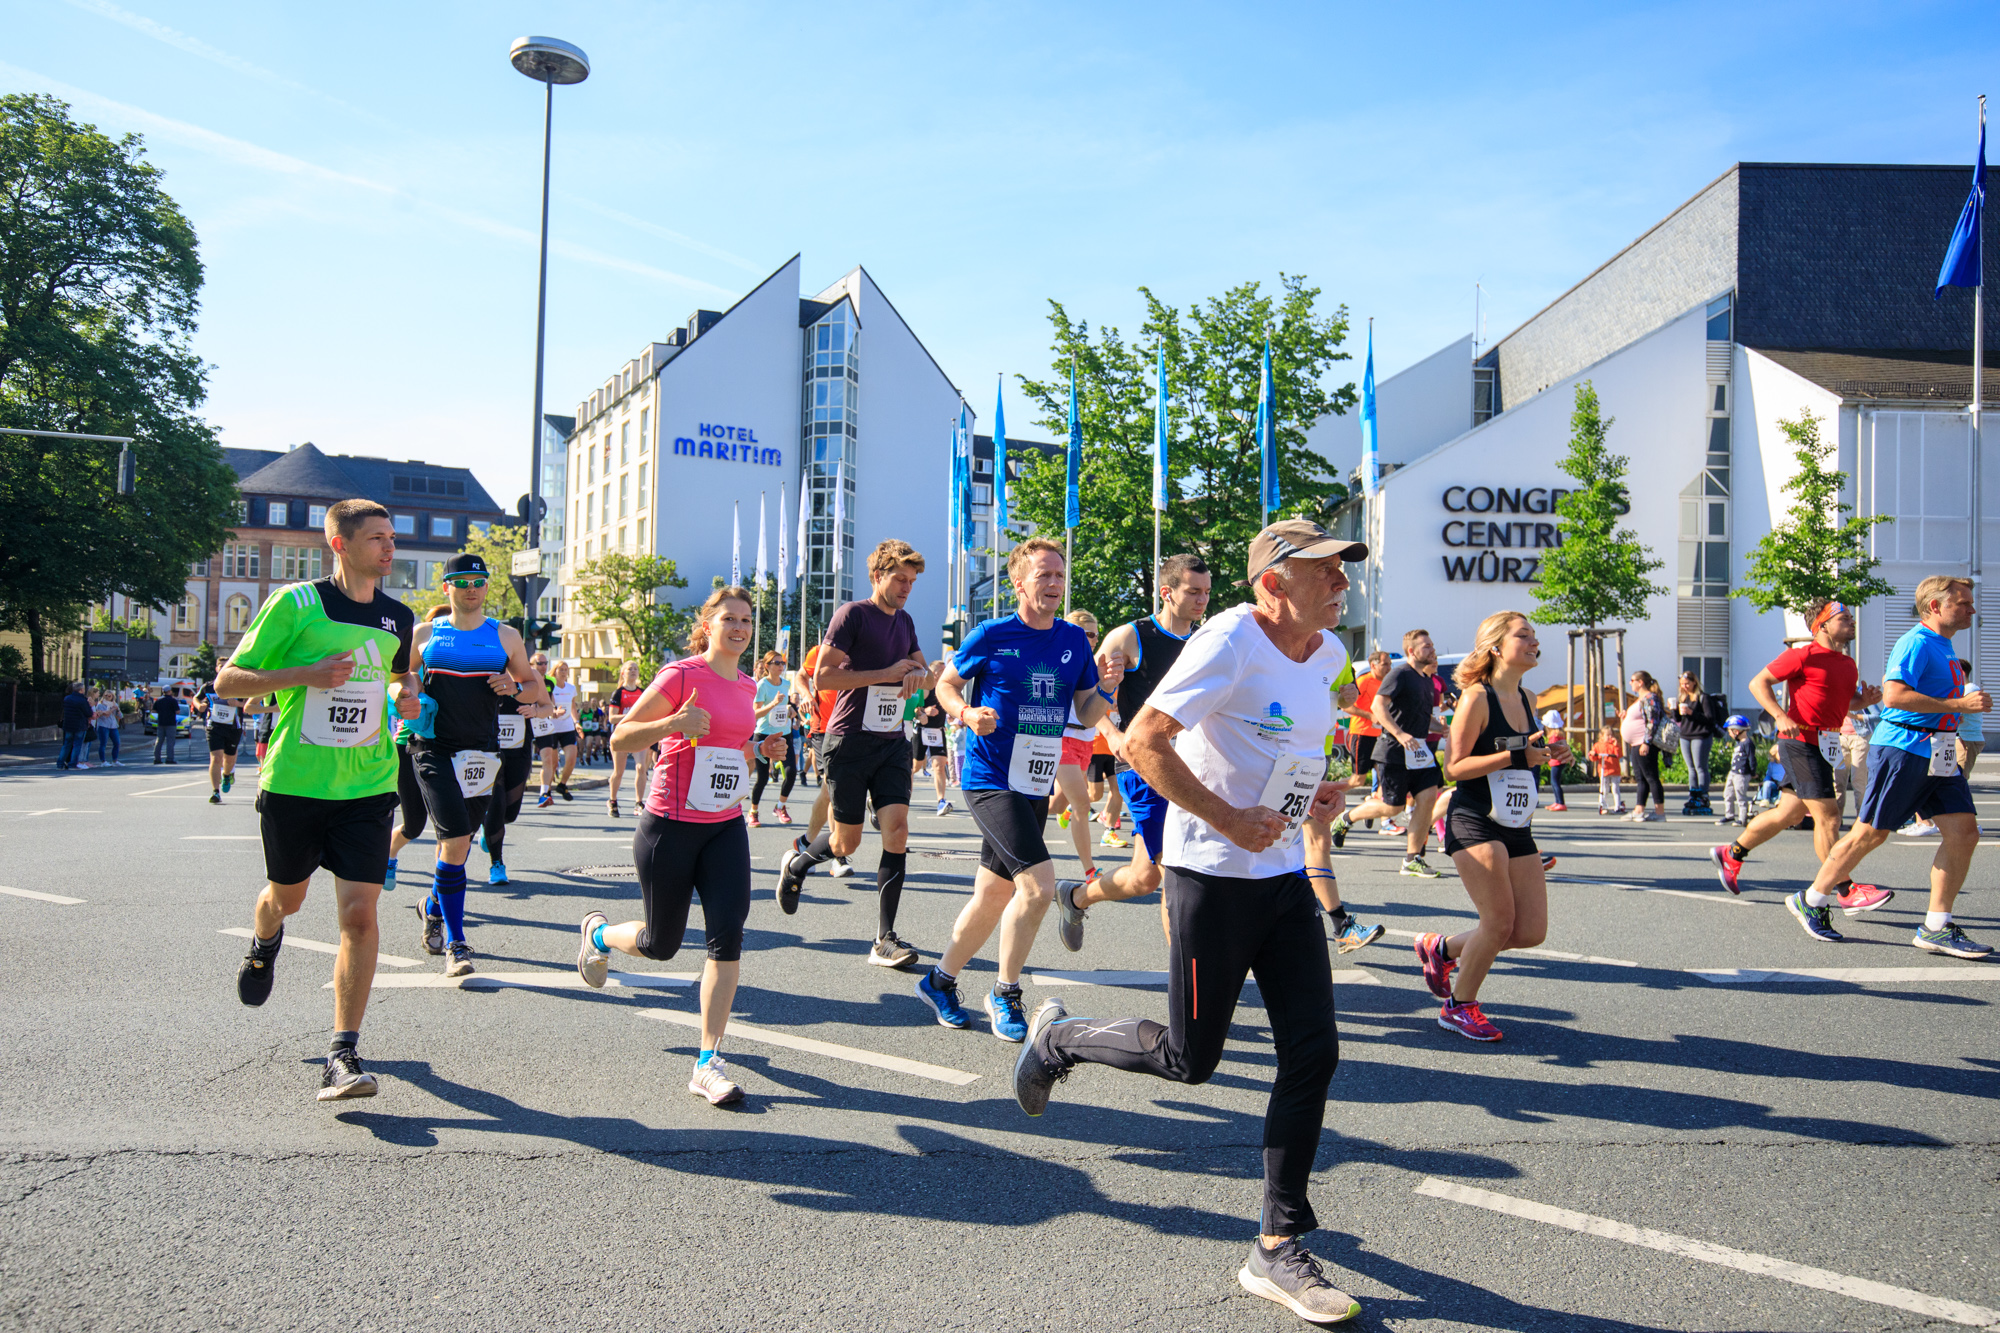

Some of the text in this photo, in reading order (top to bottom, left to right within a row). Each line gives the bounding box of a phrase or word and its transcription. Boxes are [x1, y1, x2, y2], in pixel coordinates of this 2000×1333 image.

[699, 422, 759, 443] HOTEL
[674, 437, 782, 467] MARITIM
[331, 696, 367, 704] Halbmarathon
[327, 706, 367, 725] 1321
[877, 704, 898, 717] 1163
[1018, 714, 1047, 722] MARATHON
[1046, 715, 1053, 723] DE
[331, 725, 359, 734] Yannick
[1017, 723, 1064, 736] FINISHER
[464, 766, 486, 781] 1526
[1027, 758, 1056, 776] 1972
[709, 772, 740, 791] 1957
[1031, 776, 1050, 784] Roland
[713, 791, 731, 799] Annika
[1505, 791, 1530, 808] 2173
[1279, 792, 1310, 818] 253
